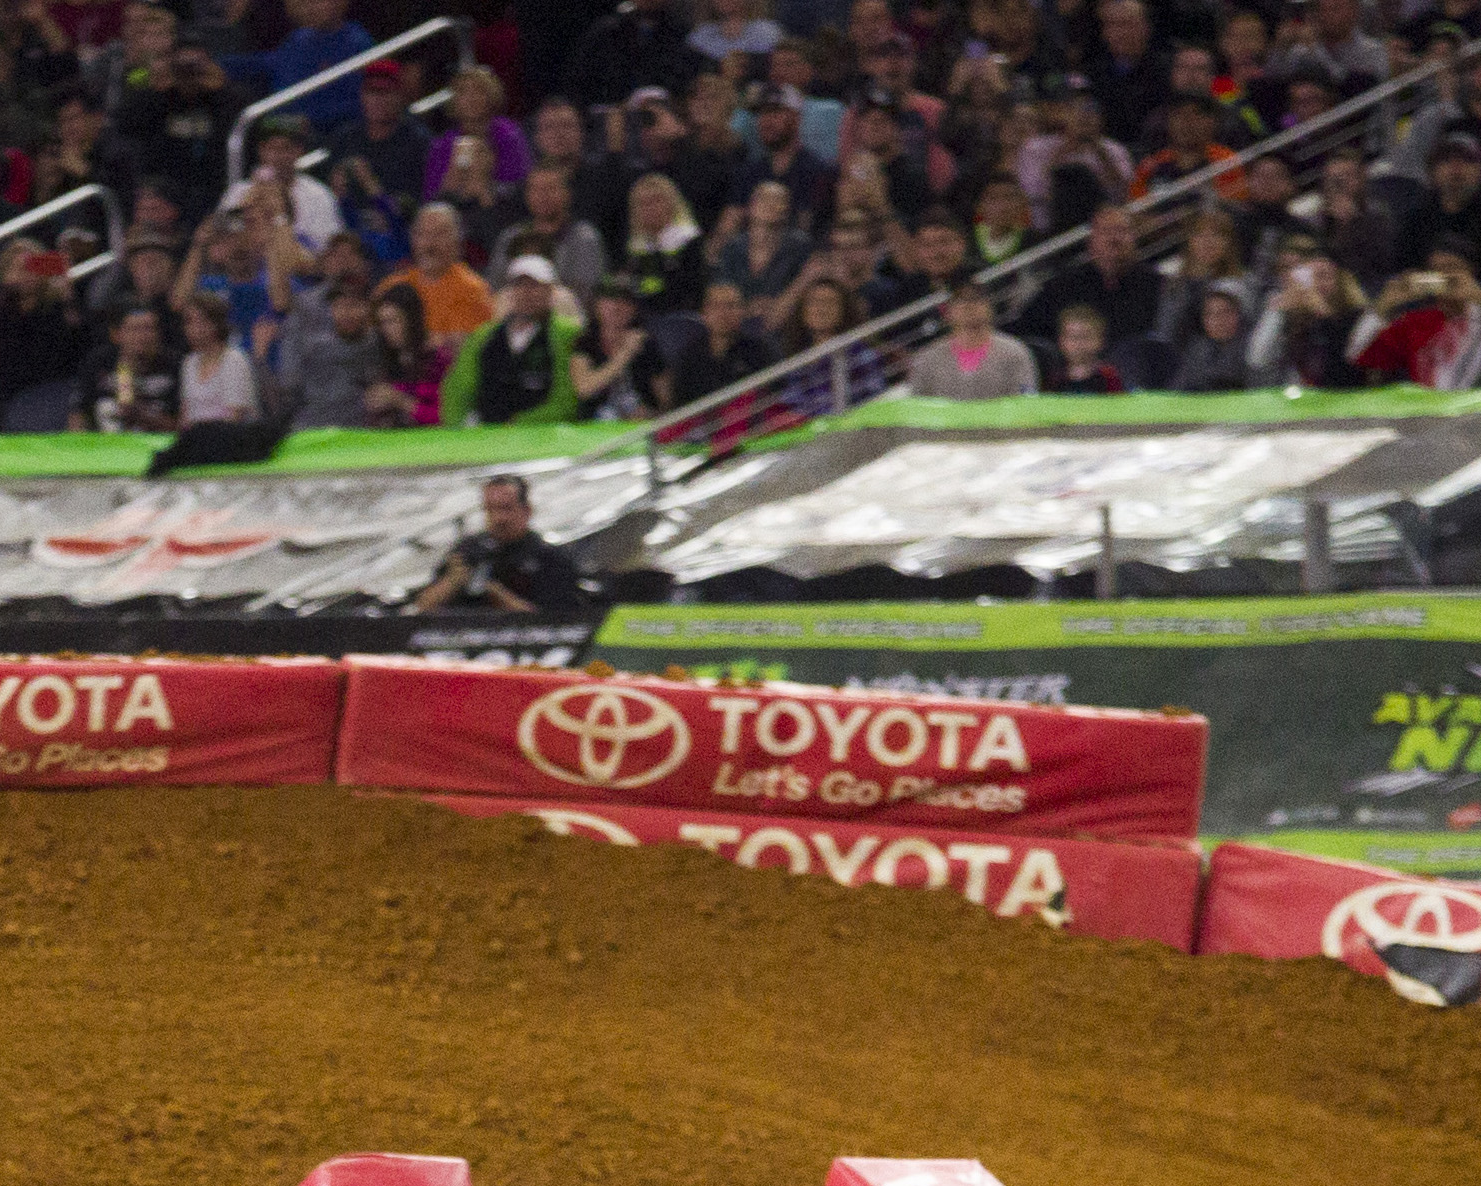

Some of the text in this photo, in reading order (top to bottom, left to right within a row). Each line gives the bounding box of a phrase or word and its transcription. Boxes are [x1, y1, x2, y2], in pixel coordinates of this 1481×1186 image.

[710, 697, 1031, 773] TOYOTA
[39, 742, 170, 775] Places
[712, 762, 811, 801] Let's
[820, 770, 882, 806] Go
